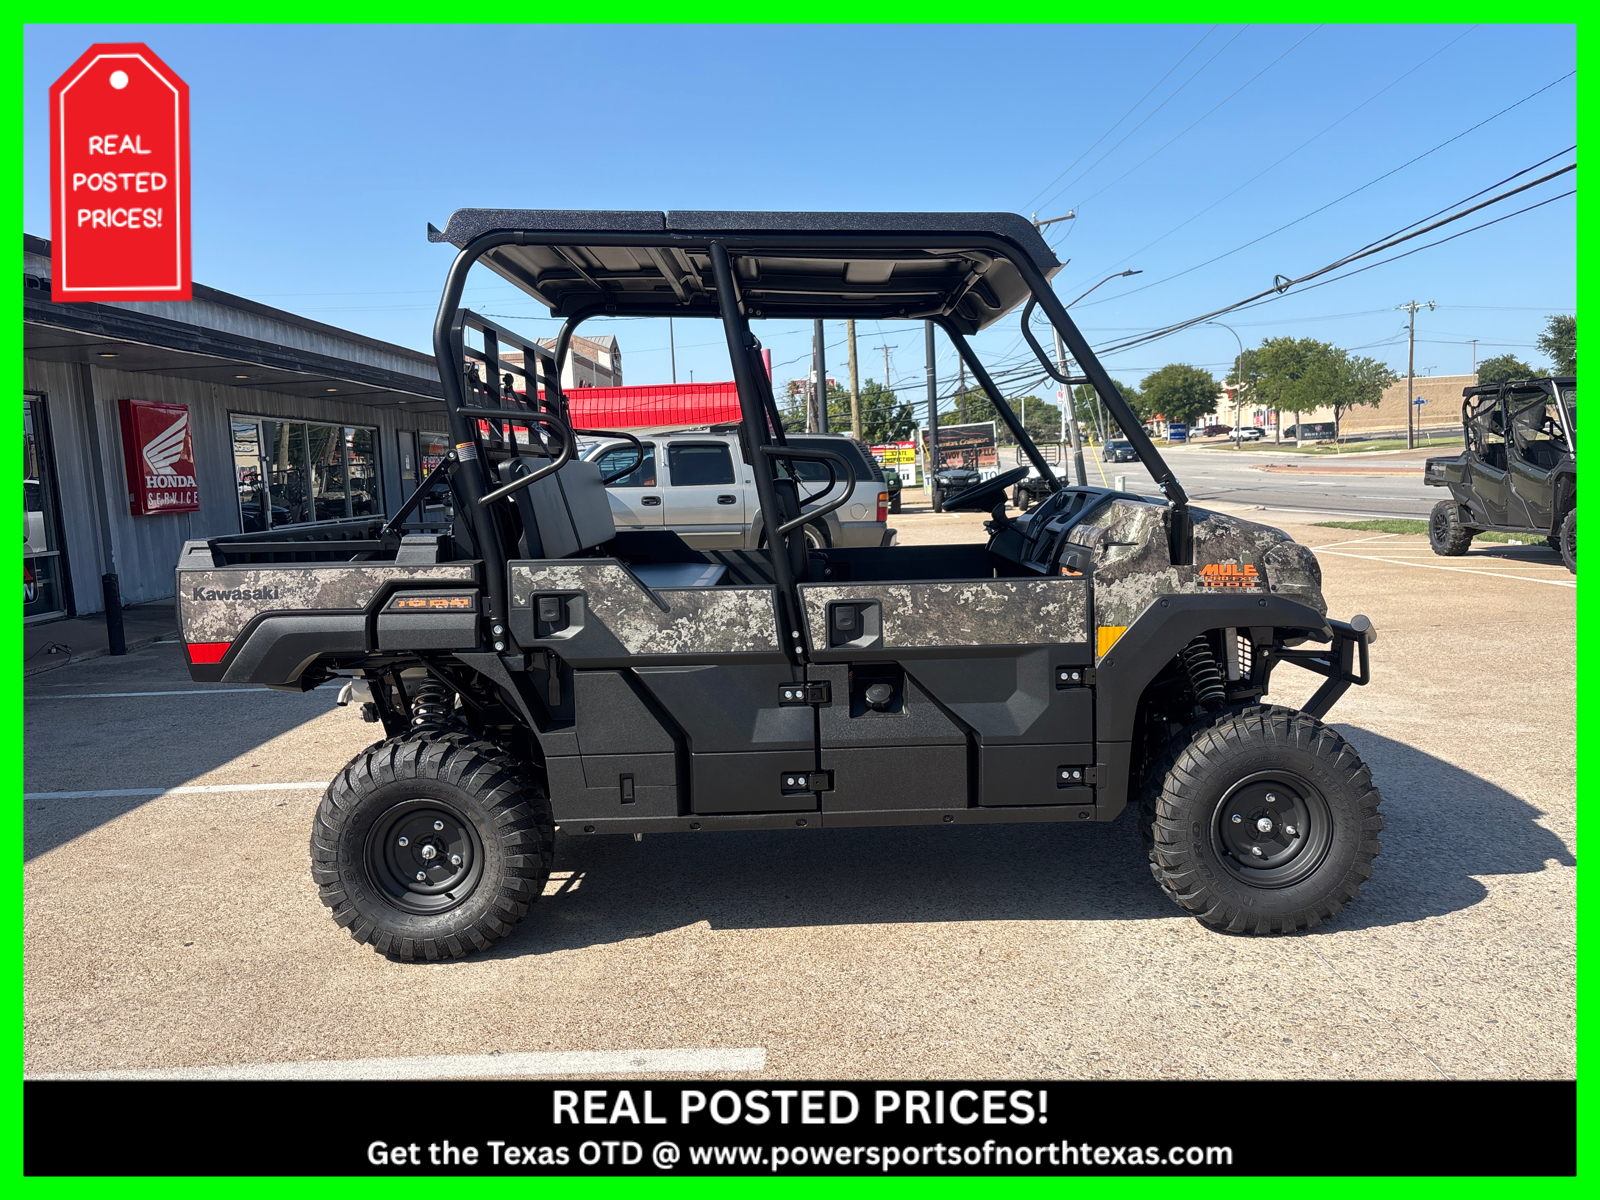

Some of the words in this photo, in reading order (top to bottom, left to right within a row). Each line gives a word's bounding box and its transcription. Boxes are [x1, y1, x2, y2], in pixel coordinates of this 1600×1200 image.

[146, 475, 197, 489] HONDA
[148, 492, 198, 506] SERVICE
[1200, 564, 1259, 576] MULE
[193, 585, 279, 602] Kawasaki
